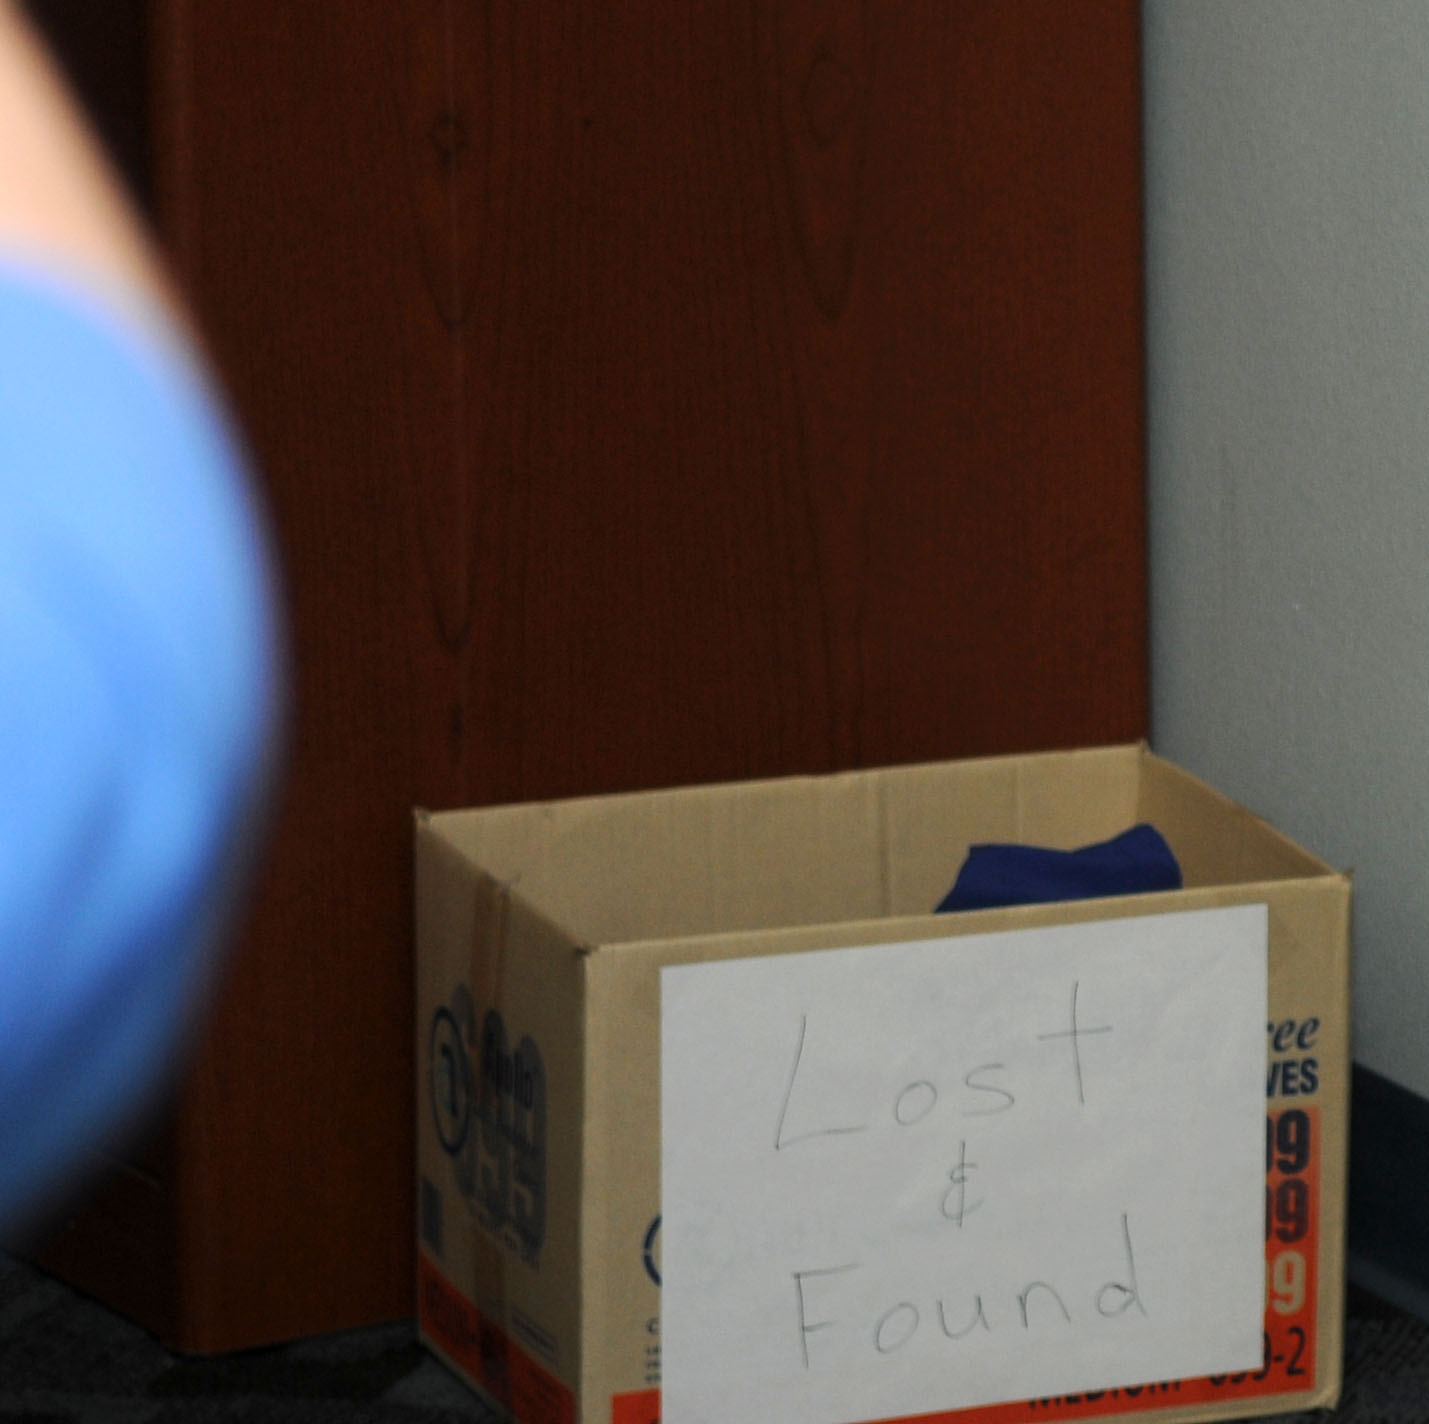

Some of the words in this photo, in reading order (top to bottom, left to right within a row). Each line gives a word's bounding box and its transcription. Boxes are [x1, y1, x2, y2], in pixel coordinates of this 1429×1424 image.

[776, 980, 1113, 1150] Lost
[1267, 1018, 1319, 1053] ee
[792, 1212, 1148, 1369] Found
